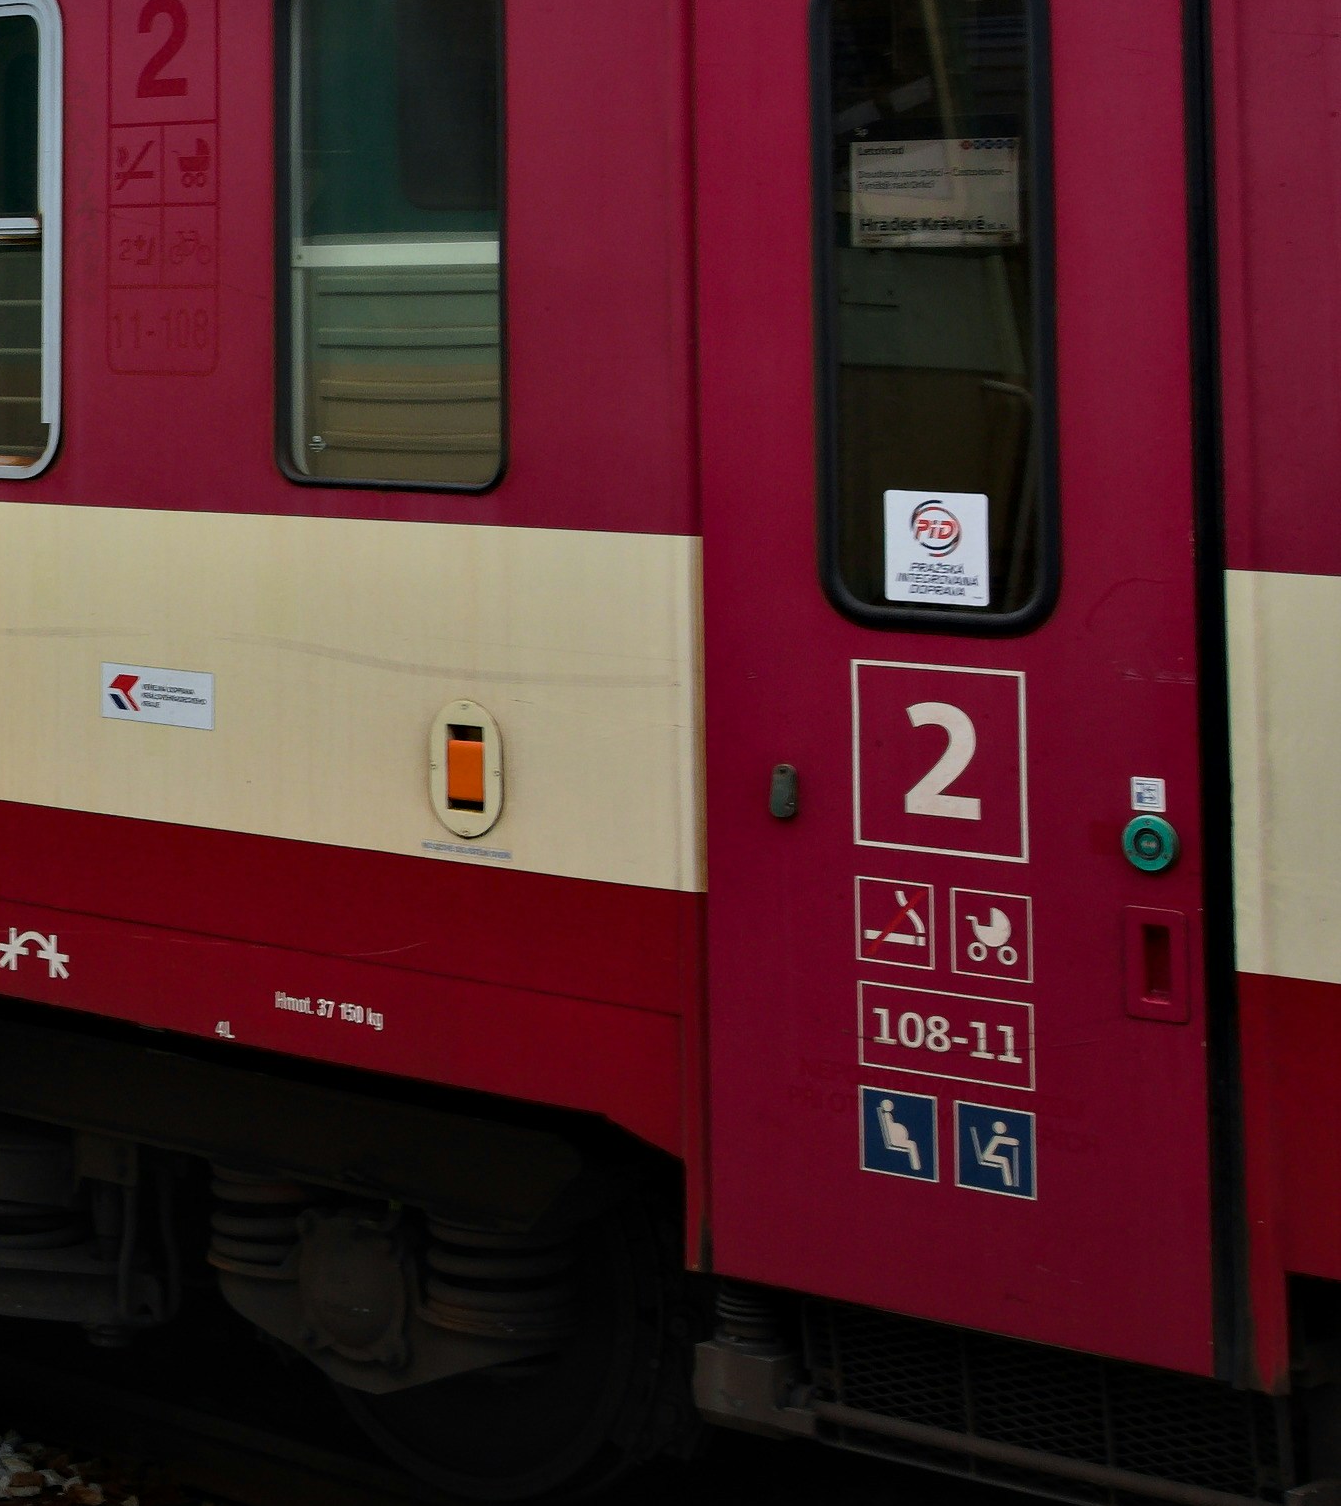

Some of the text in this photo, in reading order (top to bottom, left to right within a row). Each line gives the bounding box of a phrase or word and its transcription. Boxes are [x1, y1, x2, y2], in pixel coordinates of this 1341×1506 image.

[860, 217, 917, 231] Hradec
[920, 215, 985, 231] Králové
[904, 701, 982, 821] 2
[274, 990, 384, 1031] Hmot. 37 150 kg
[871, 1005, 1022, 1065] 108-11
